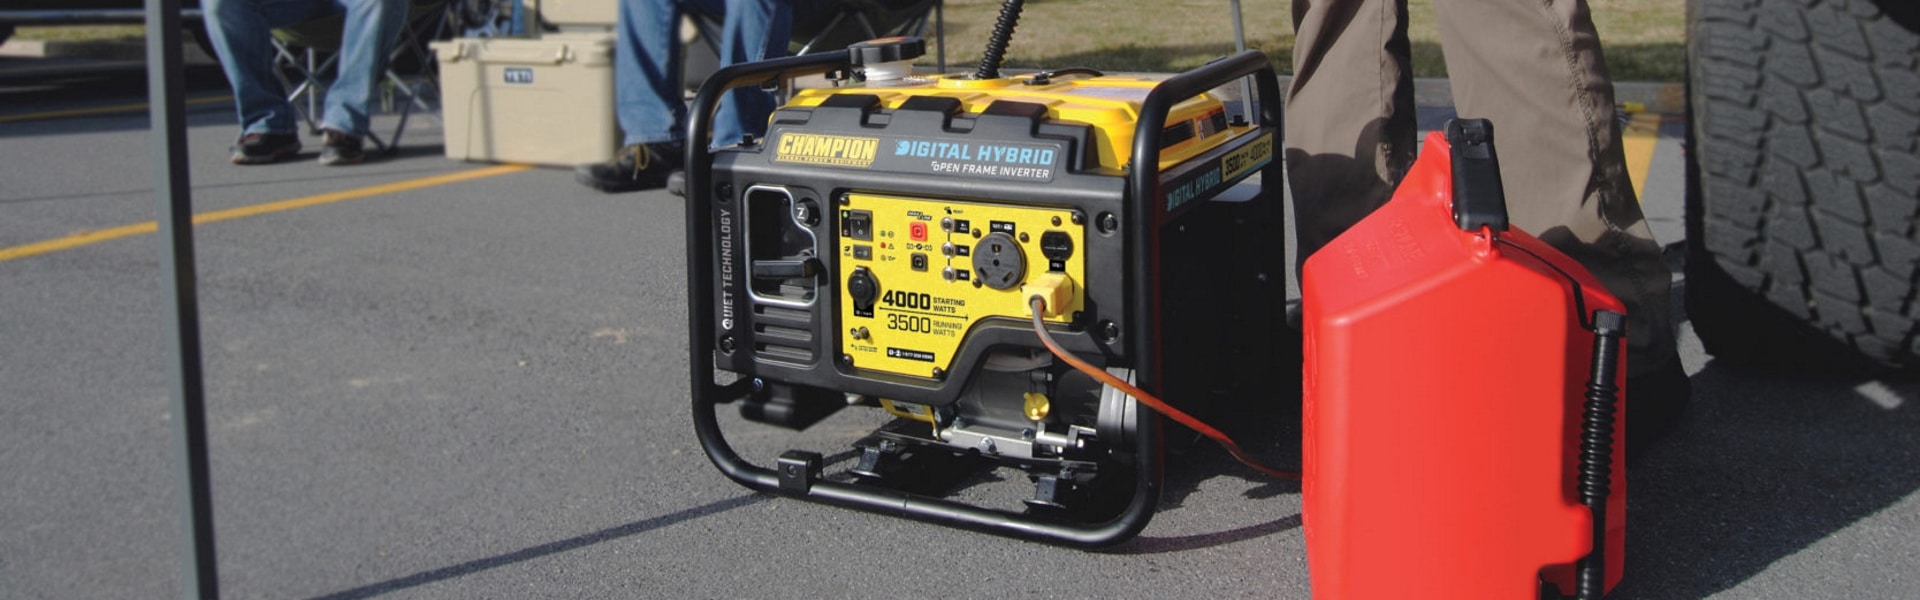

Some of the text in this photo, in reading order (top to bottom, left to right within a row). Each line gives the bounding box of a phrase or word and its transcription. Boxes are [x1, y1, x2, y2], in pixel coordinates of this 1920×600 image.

[506, 70, 532, 81] YETI
[779, 134, 877, 160] CHAMPION
[895, 139, 1054, 165] DIGITAL HYBRID
[962, 164, 998, 175] FRAME
[1000, 167, 1050, 178] INVERTER
[1166, 167, 1220, 212] DIGITAL HYBRID
[720, 208, 733, 330] QUIET TECHNOLOGY
[882, 289, 965, 310] 4000 STARTING
[933, 305, 956, 313] WATTS
[887, 313, 962, 334] 3500 RUNNING
[933, 329, 955, 337] WATTS
